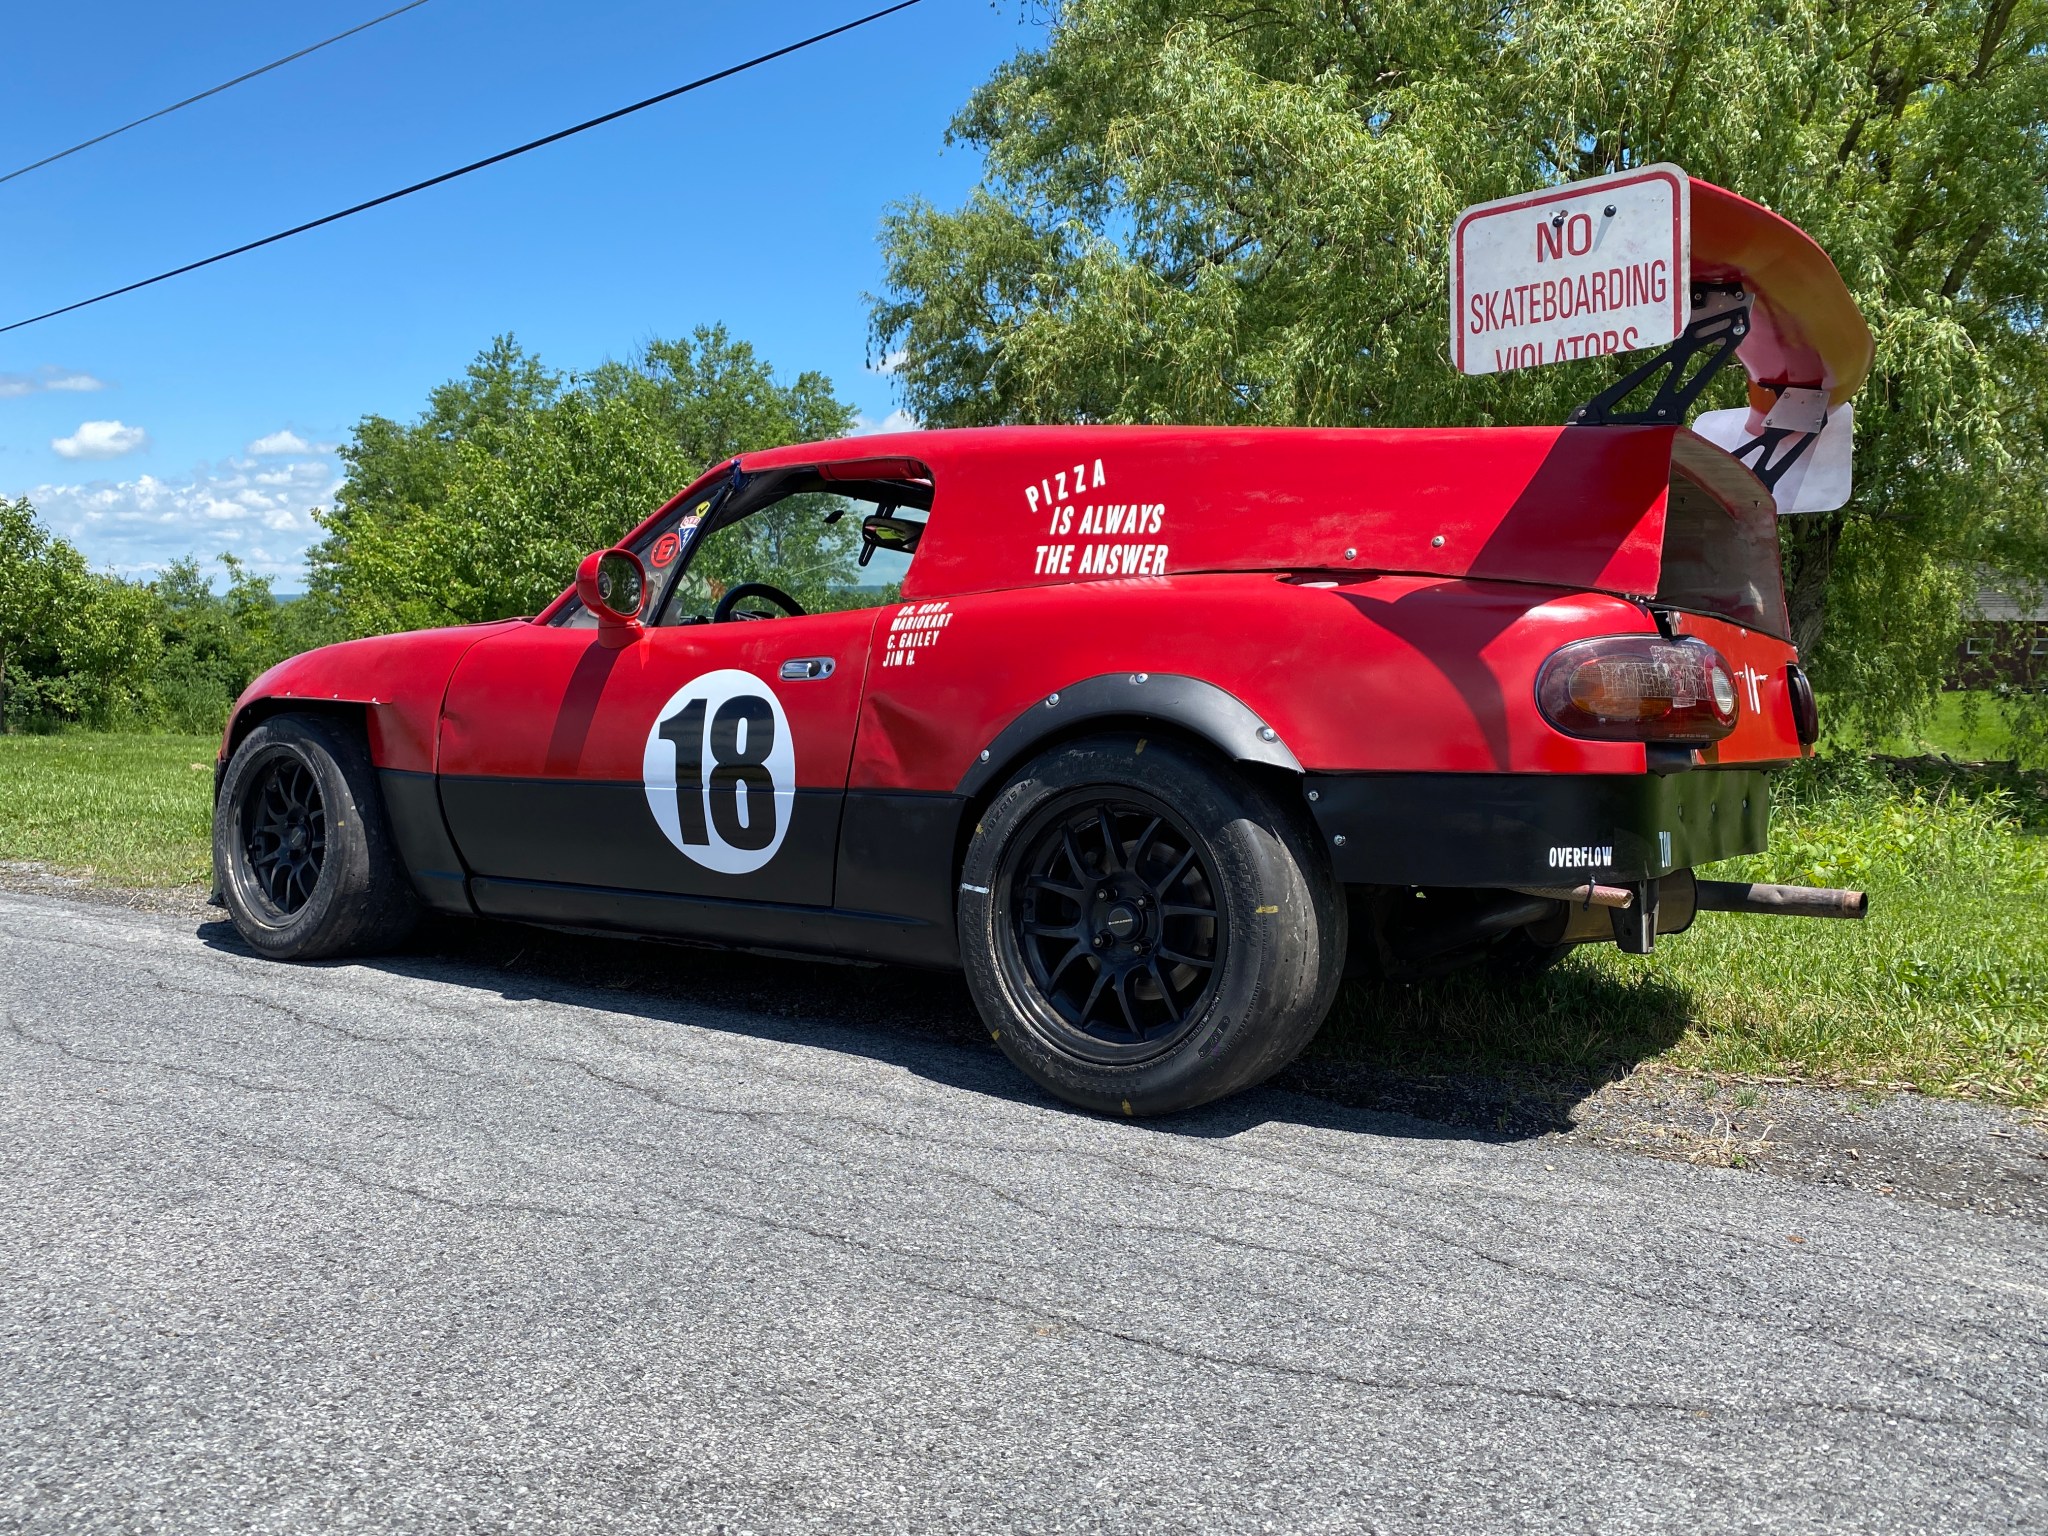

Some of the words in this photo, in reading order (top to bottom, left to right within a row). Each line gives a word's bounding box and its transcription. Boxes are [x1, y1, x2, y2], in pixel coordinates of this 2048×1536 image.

[1537, 213, 1592, 263] NO
[1470, 259, 1667, 335] SKATEBOARDING
[1024, 458, 1106, 513] PIZZA
[1049, 506, 1075, 535] IS
[1078, 503, 1165, 535] ALWAYS
[1034, 545, 1075, 575] THE
[1078, 544, 1169, 575] ANSWER
[890, 613, 954, 632] MARIOKART
[917, 601, 950, 615] KORF
[887, 634, 896, 650] C.
[898, 630, 940, 648] GAILEY
[882, 650, 905, 667] JIM
[905, 650, 916, 666] H.
[658, 694, 777, 851] 18
[1549, 846, 1613, 868] OVERFLOW
